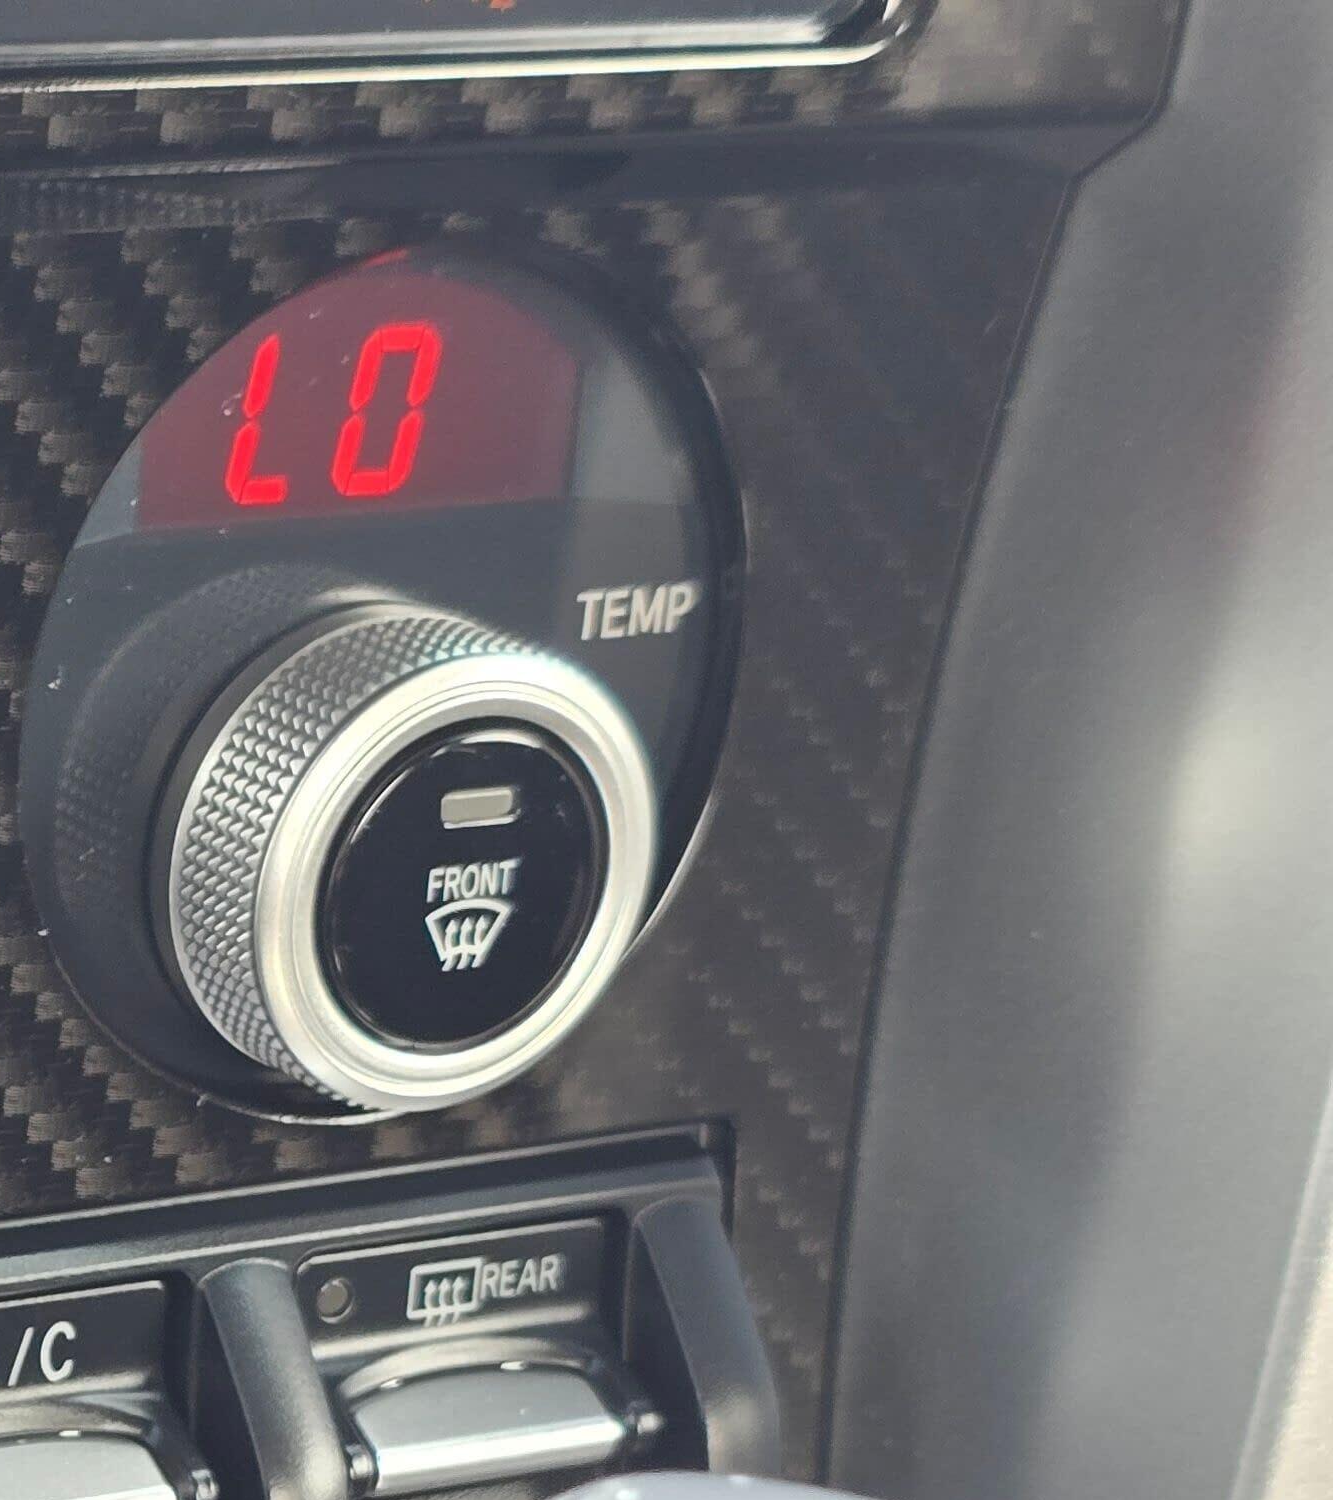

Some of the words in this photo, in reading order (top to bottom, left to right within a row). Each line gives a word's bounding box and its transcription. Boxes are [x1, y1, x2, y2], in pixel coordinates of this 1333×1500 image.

[575, 581, 701, 641] TEMP
[426, 857, 524, 903] FRONT
[479, 1252, 564, 1300] REAR
